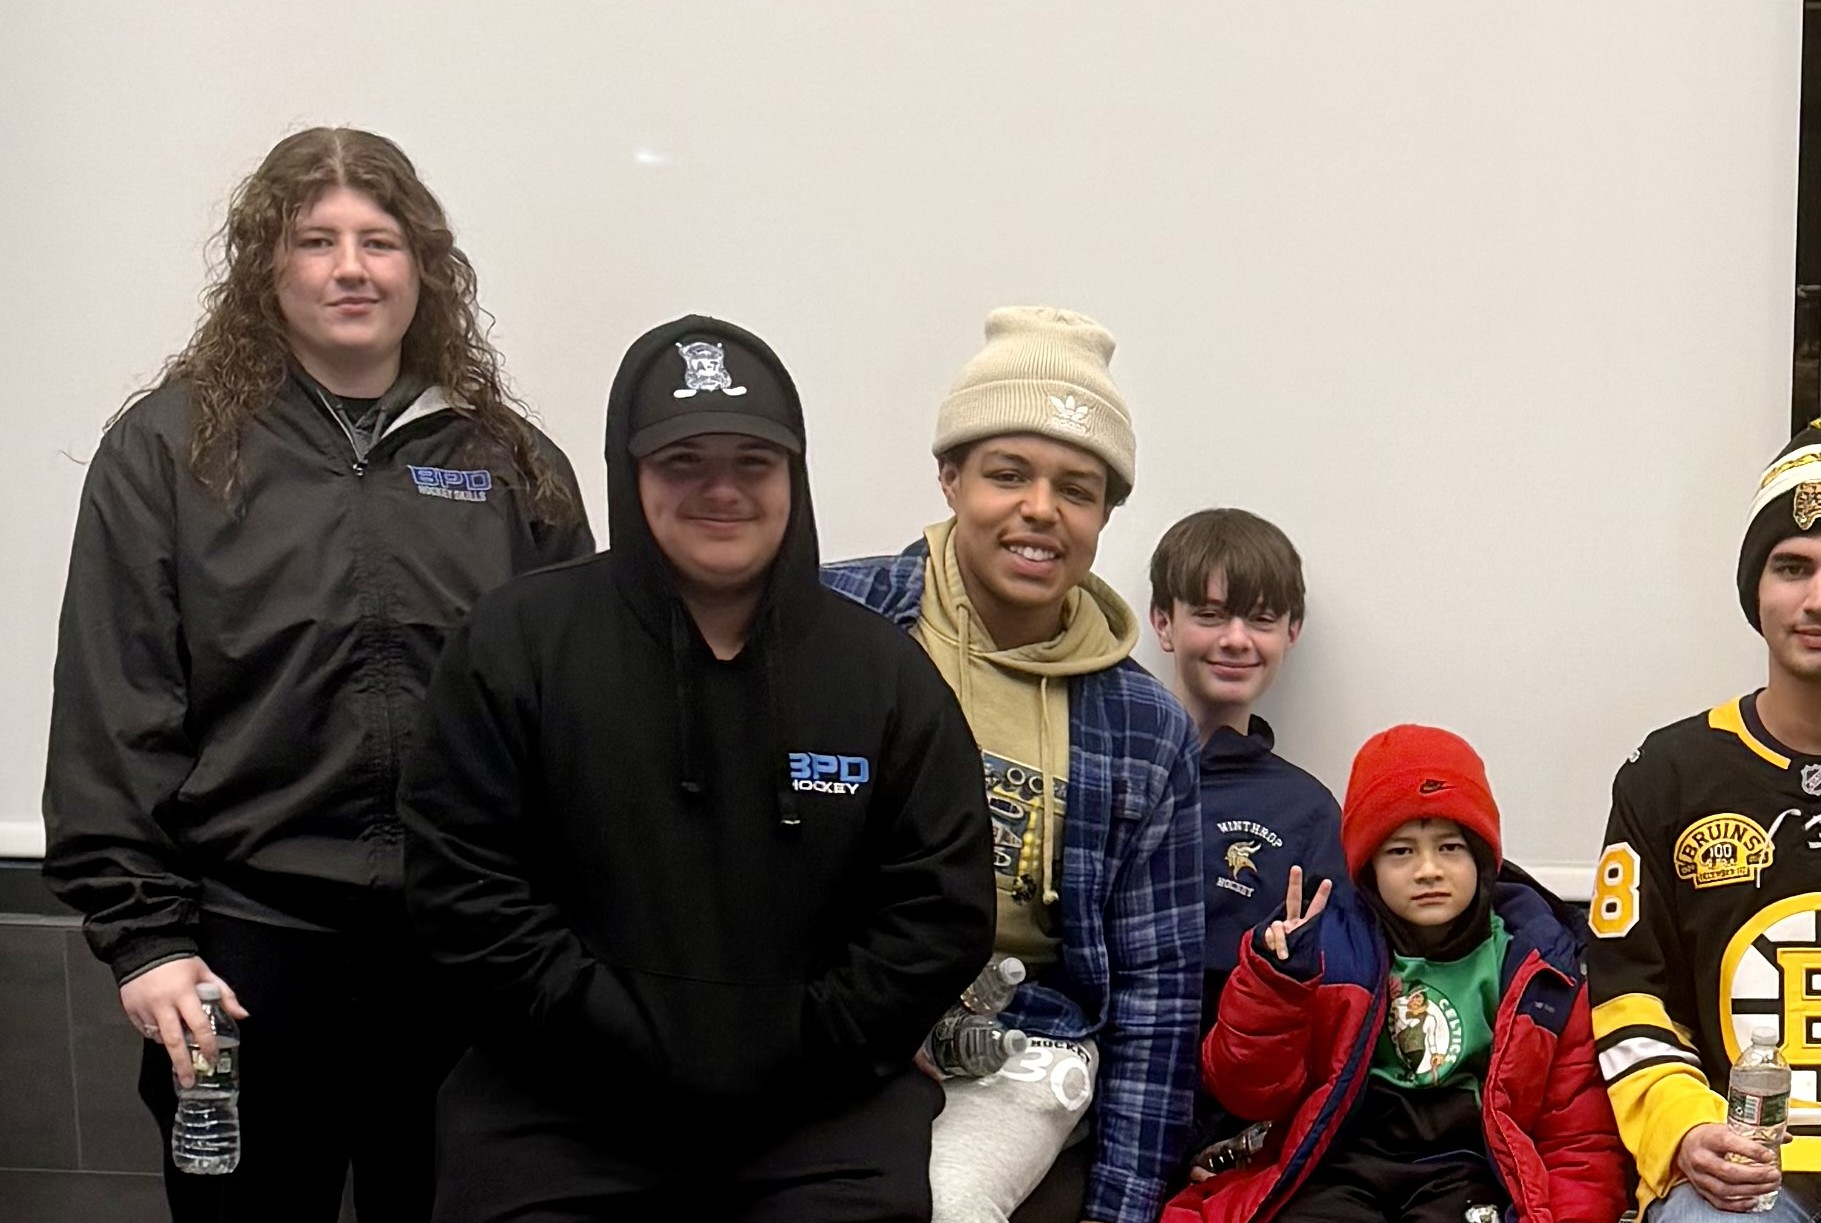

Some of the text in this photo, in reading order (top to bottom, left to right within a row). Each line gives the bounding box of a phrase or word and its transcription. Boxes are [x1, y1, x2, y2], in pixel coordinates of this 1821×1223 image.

[406, 464, 493, 491] BPD
[788, 751, 870, 783] BPD
[1216, 820, 1284, 848] WINTHROP
[1682, 822, 1762, 859] BRUINS
[1709, 843, 1733, 859] 100
[1216, 876, 1255, 898] HOCKEY
[1588, 841, 1642, 939] 8
[1438, 997, 1463, 1064] CELTICS
